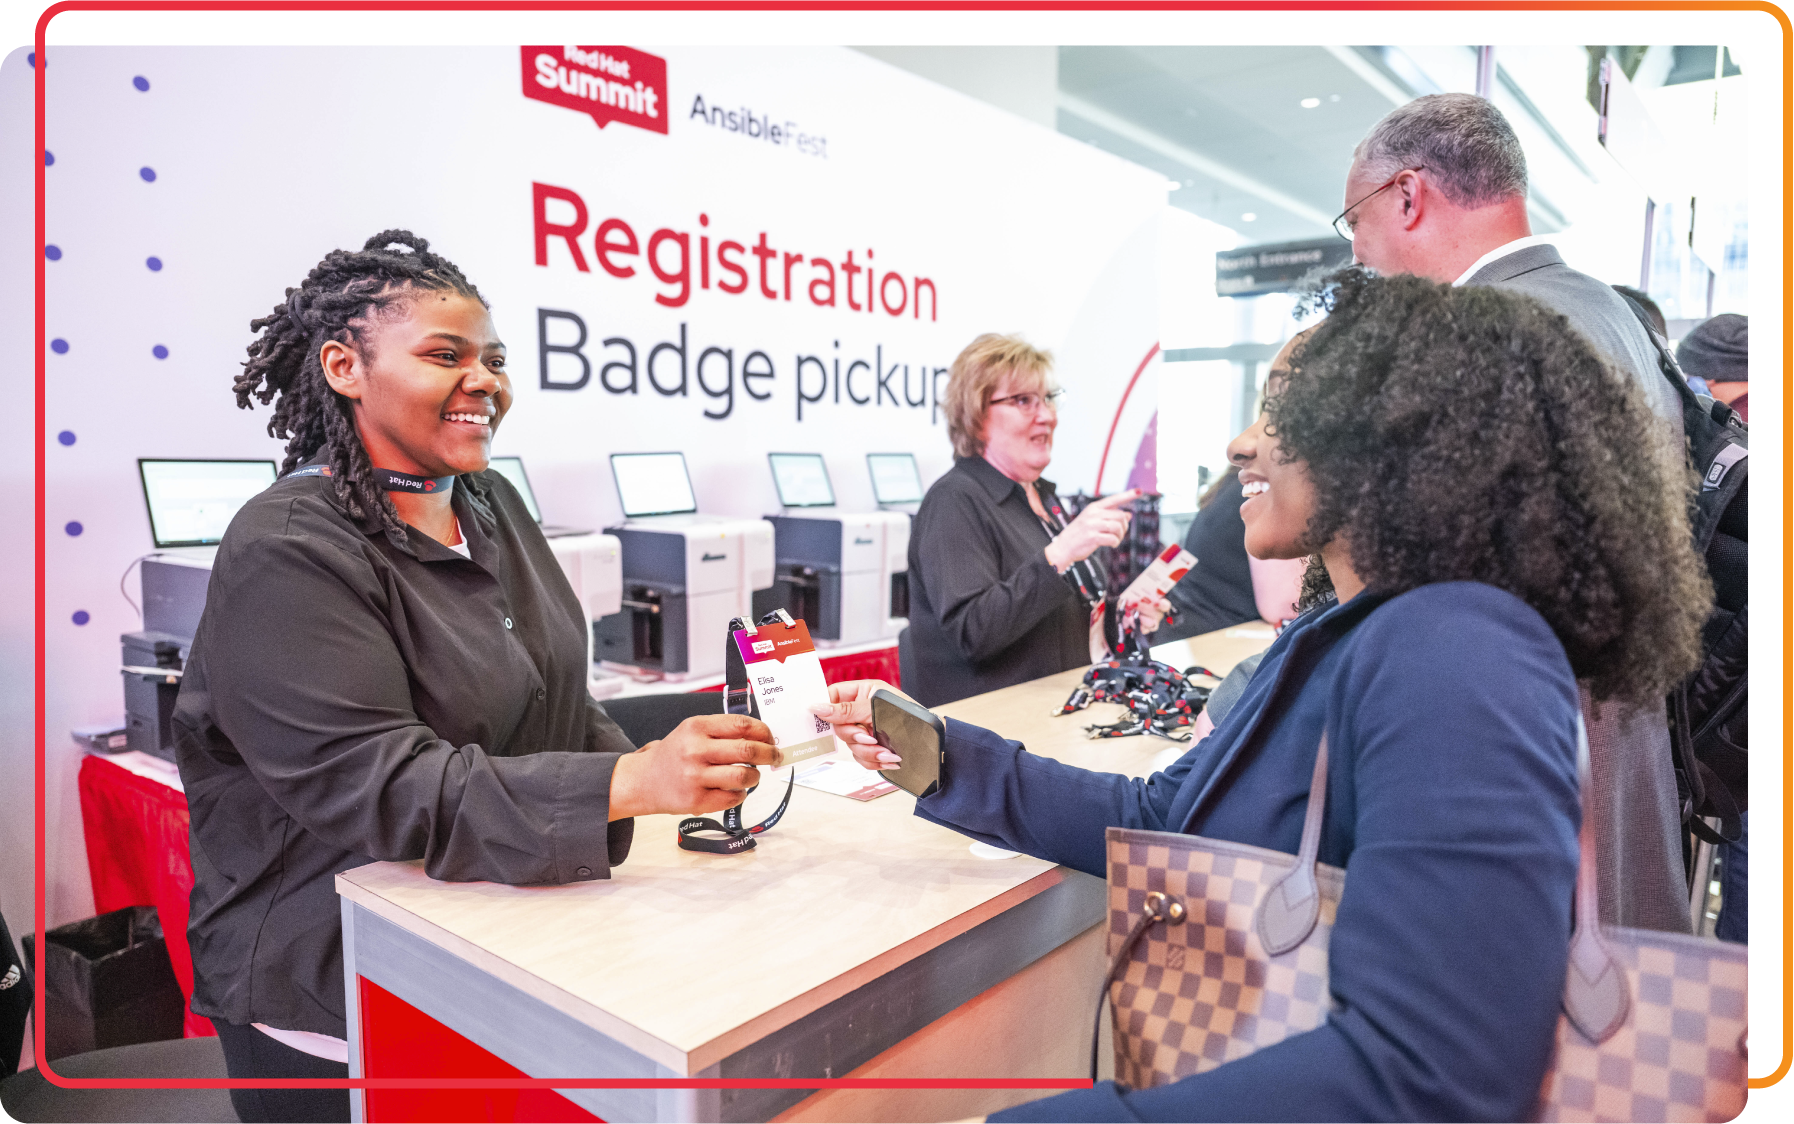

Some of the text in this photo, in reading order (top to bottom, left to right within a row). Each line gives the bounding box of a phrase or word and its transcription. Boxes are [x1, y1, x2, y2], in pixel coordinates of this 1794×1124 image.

[534, 53, 659, 119] Summit
[689, 93, 828, 159] AnsibleFest
[532, 181, 938, 322] Registration
[537, 307, 776, 421] Badge
[389, 476, 422, 489] Red Hat
[757, 676, 775, 686] Elisa
[762, 685, 784, 696] Jones
[792, 745, 818, 758] Attendee
[689, 821, 703, 829] Hat
[728, 814, 736, 828] Hat
[728, 833, 754, 849] ed Hat
